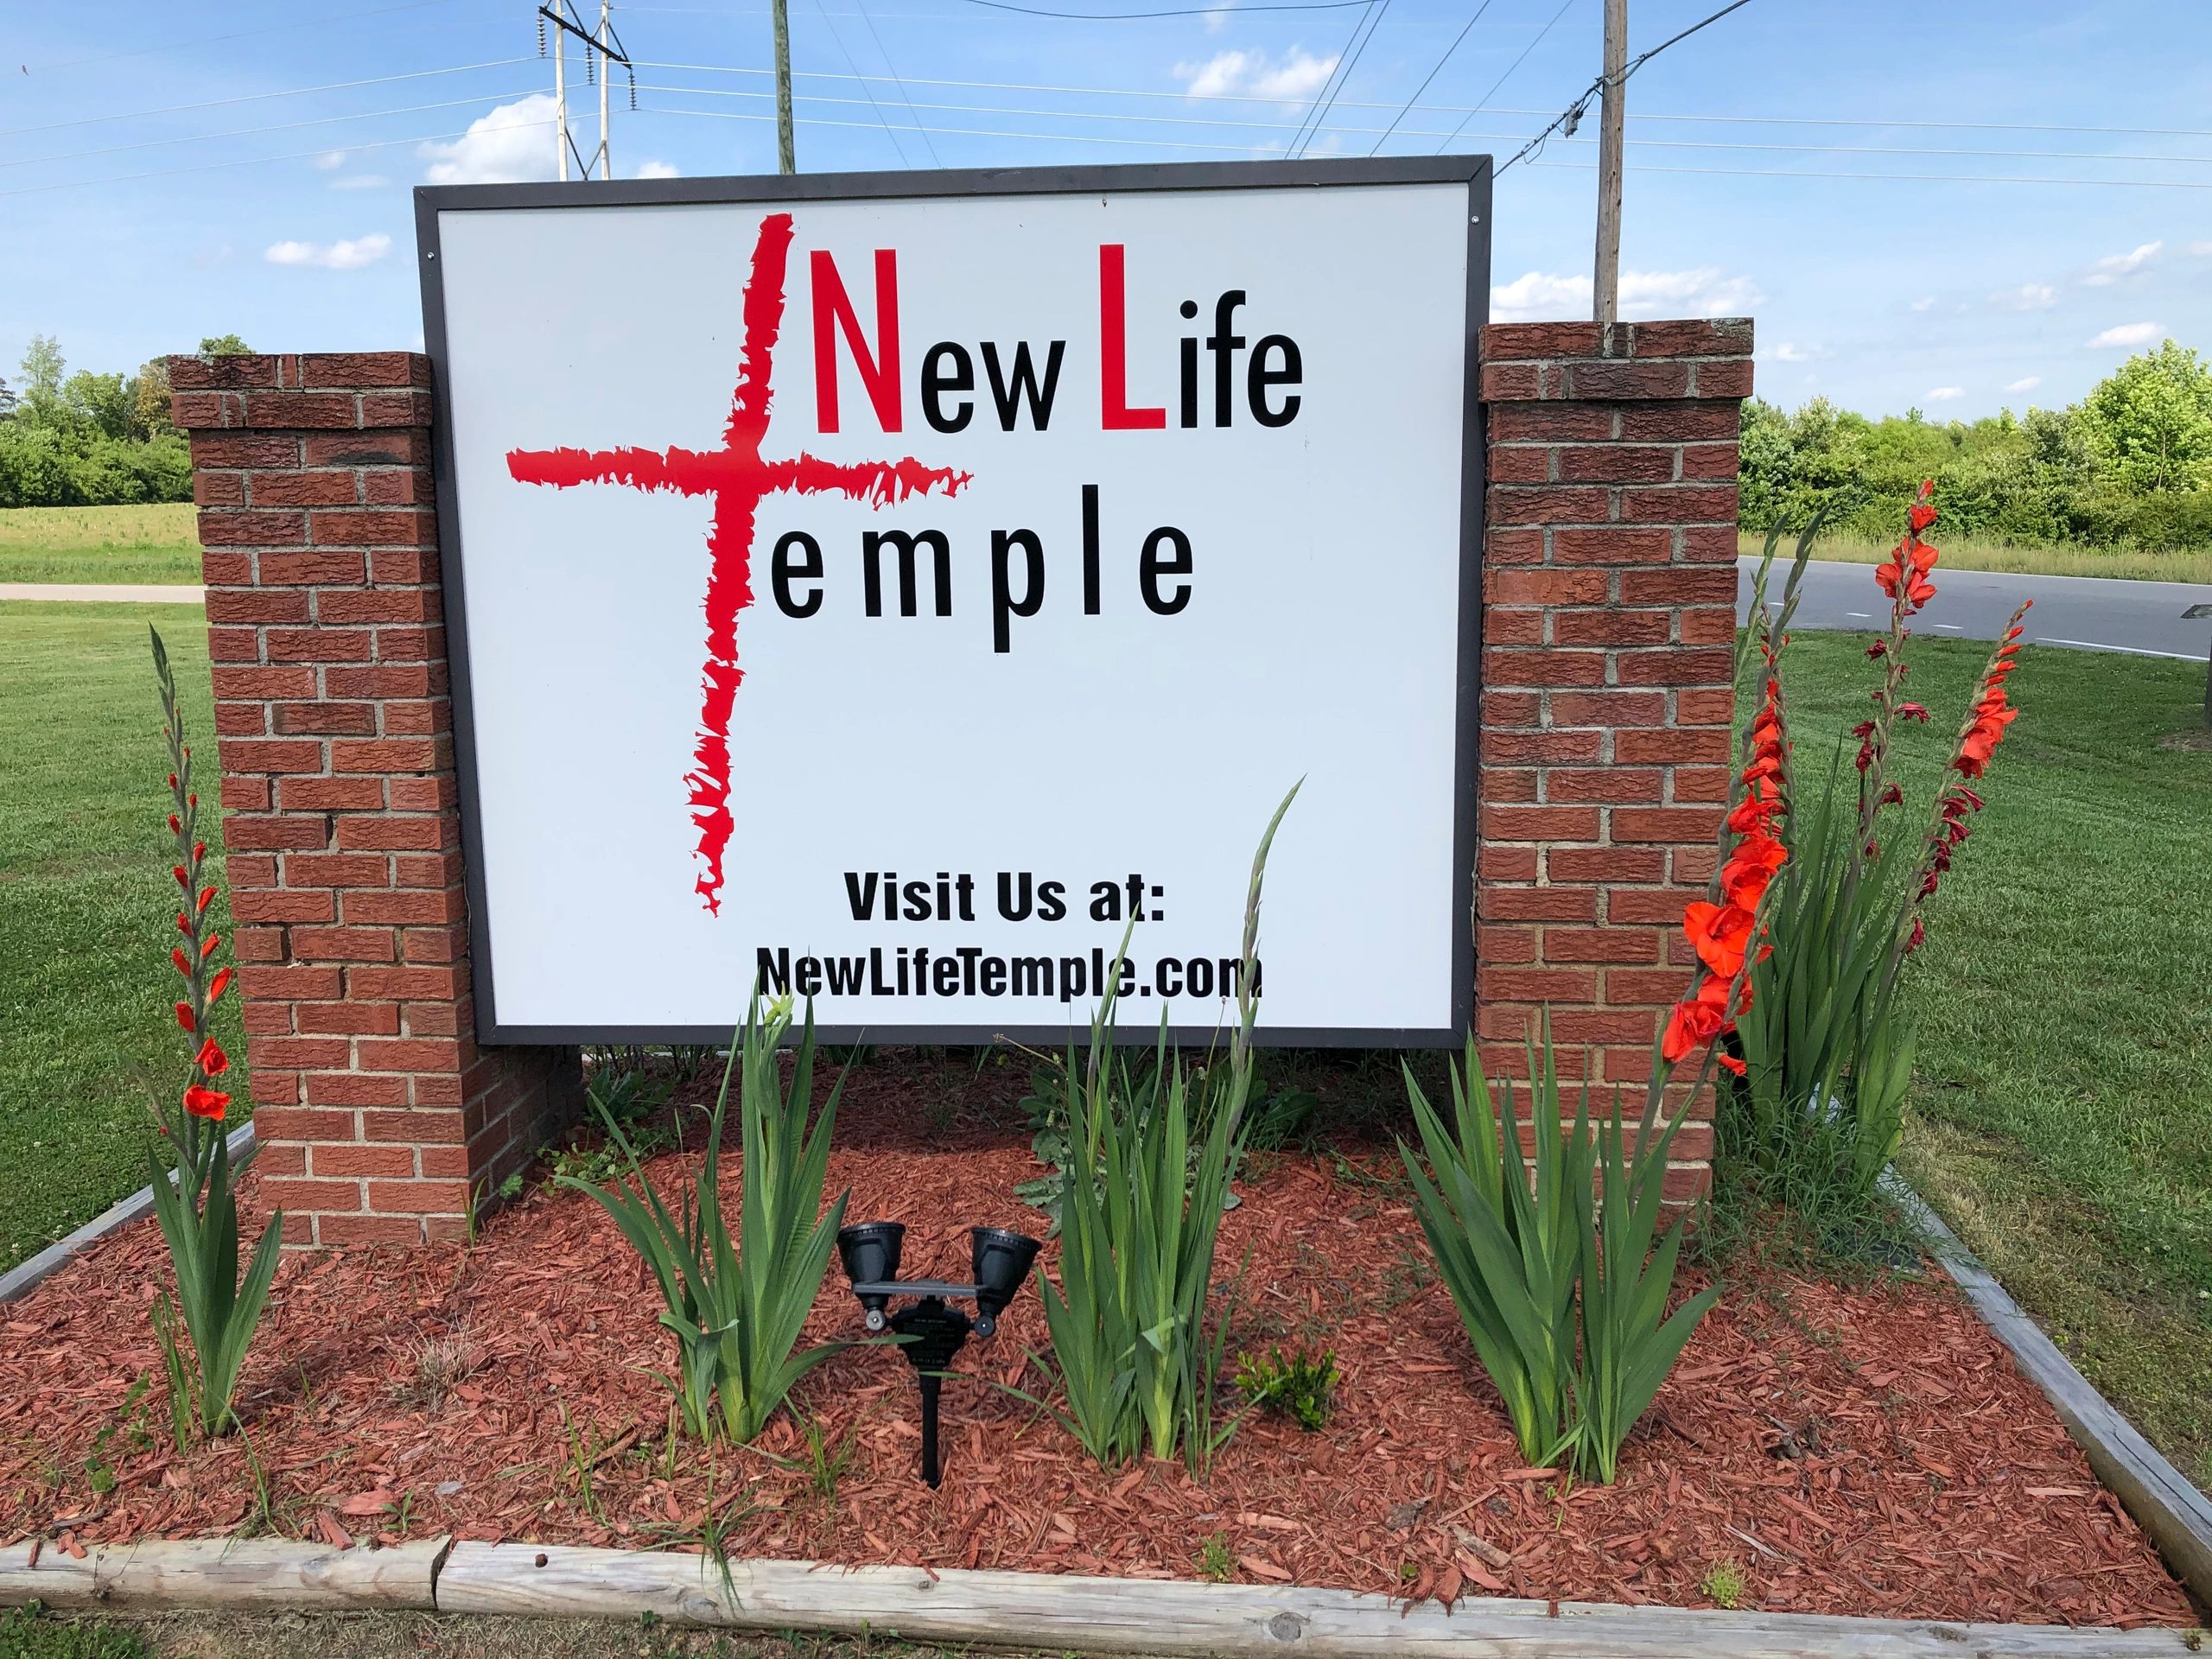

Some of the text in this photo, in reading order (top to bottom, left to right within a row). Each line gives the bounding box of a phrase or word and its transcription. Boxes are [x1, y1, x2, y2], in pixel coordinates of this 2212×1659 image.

[810, 244, 1303, 434] New Life
[843, 872, 1164, 922] Visit Us at:
[757, 947, 1262, 1002] NewLifeTemple.com
